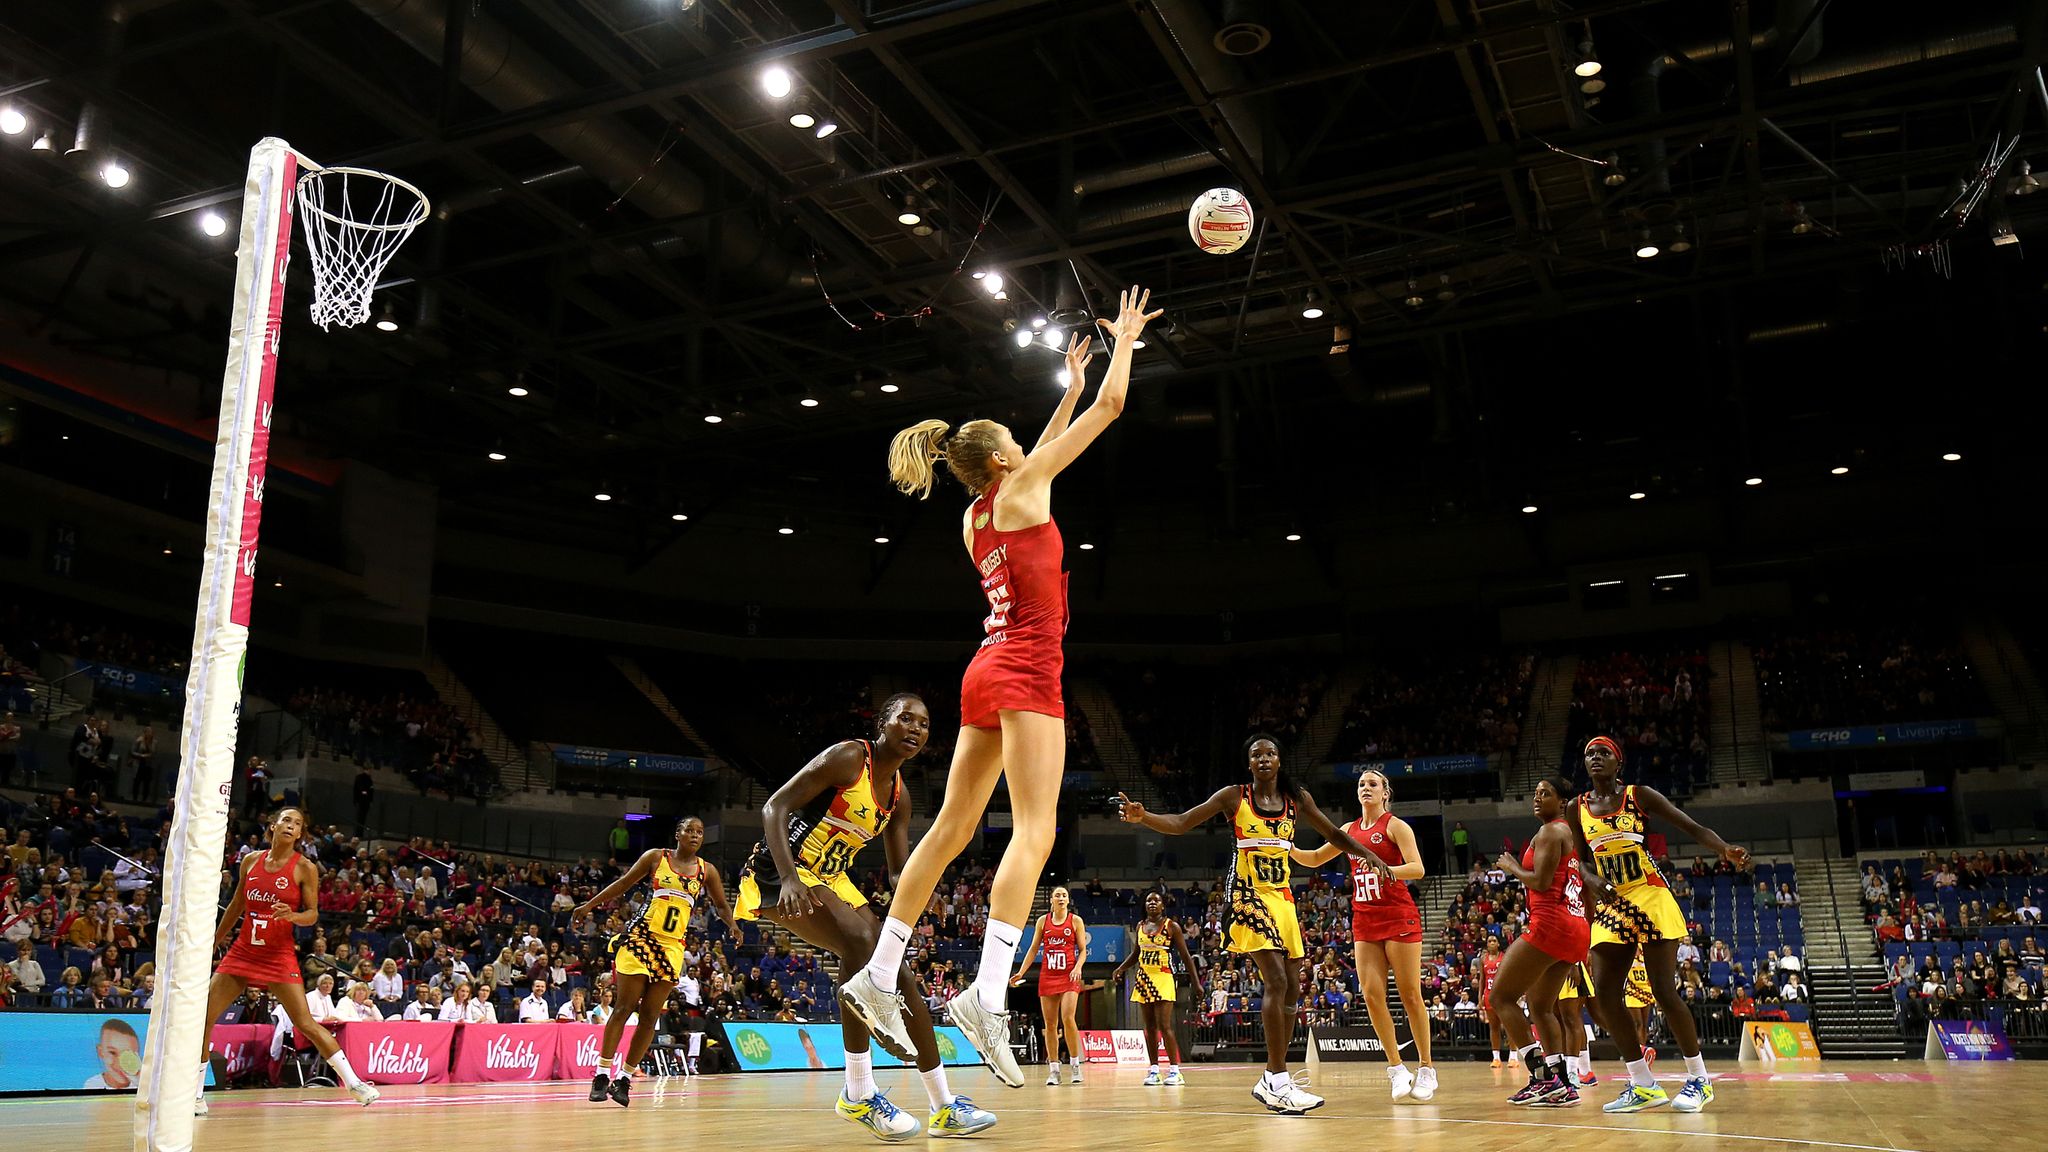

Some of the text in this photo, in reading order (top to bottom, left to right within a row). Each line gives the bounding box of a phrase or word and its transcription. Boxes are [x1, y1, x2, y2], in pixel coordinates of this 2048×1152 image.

[645, 756, 696, 771] Liverpool
[1422, 756, 1476, 771] Liverpool
[1599, 850, 1643, 885] WD
[1353, 873, 1382, 902] GA
[661, 906, 681, 933] C
[250, 919, 269, 946] C
[1046, 952, 1067, 970] WD
[1141, 949, 1161, 966] WA
[486, 1033, 540, 1079] Vitality
[737, 1034, 771, 1059] laffa
[1083, 1034, 1113, 1055] Vitality
[1116, 1034, 1144, 1055] Vitality
[368, 1035, 429, 1083] Vitality
